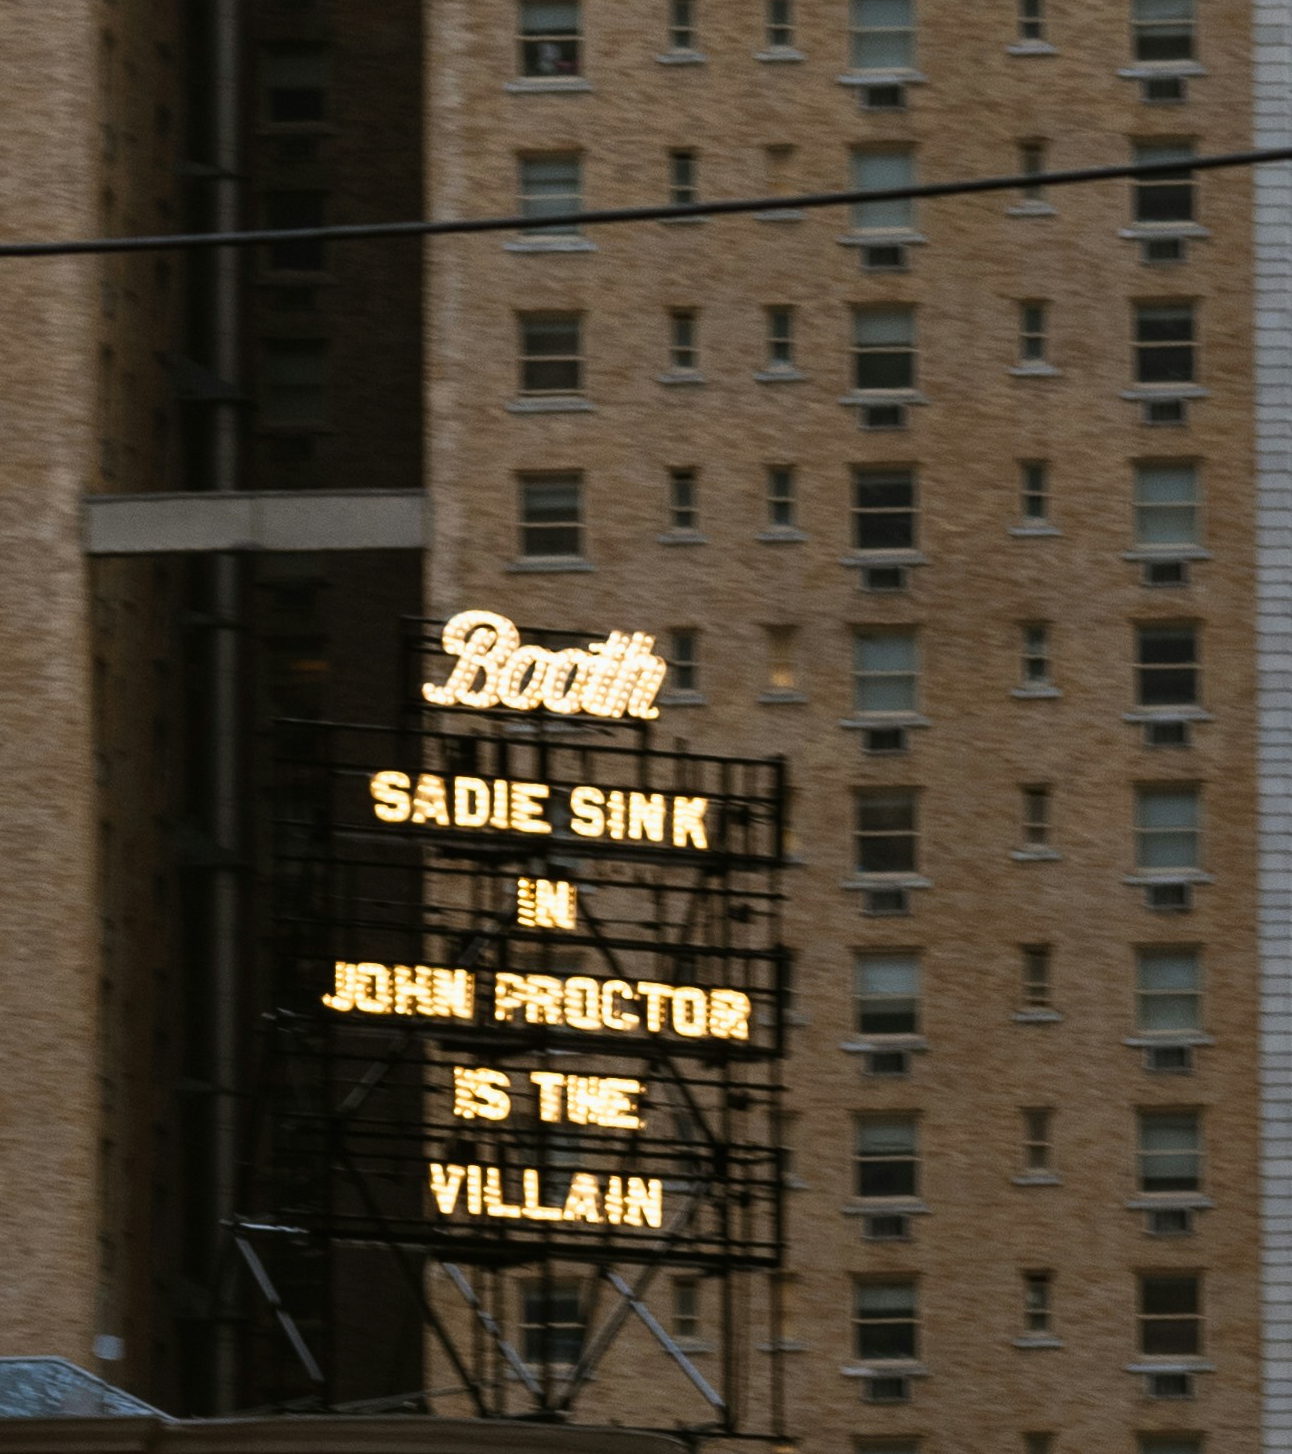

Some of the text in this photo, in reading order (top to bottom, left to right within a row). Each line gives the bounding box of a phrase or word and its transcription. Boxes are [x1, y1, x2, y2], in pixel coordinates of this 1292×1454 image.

[422, 608, 668, 721] Booth
[369, 770, 709, 850] SADIE SINK
[516, 877, 578, 931] IN
[321, 960, 752, 1041] JOHN PROCTOR
[452, 1066, 647, 1130] IS THE
[429, 1161, 664, 1229] VILLAIN
